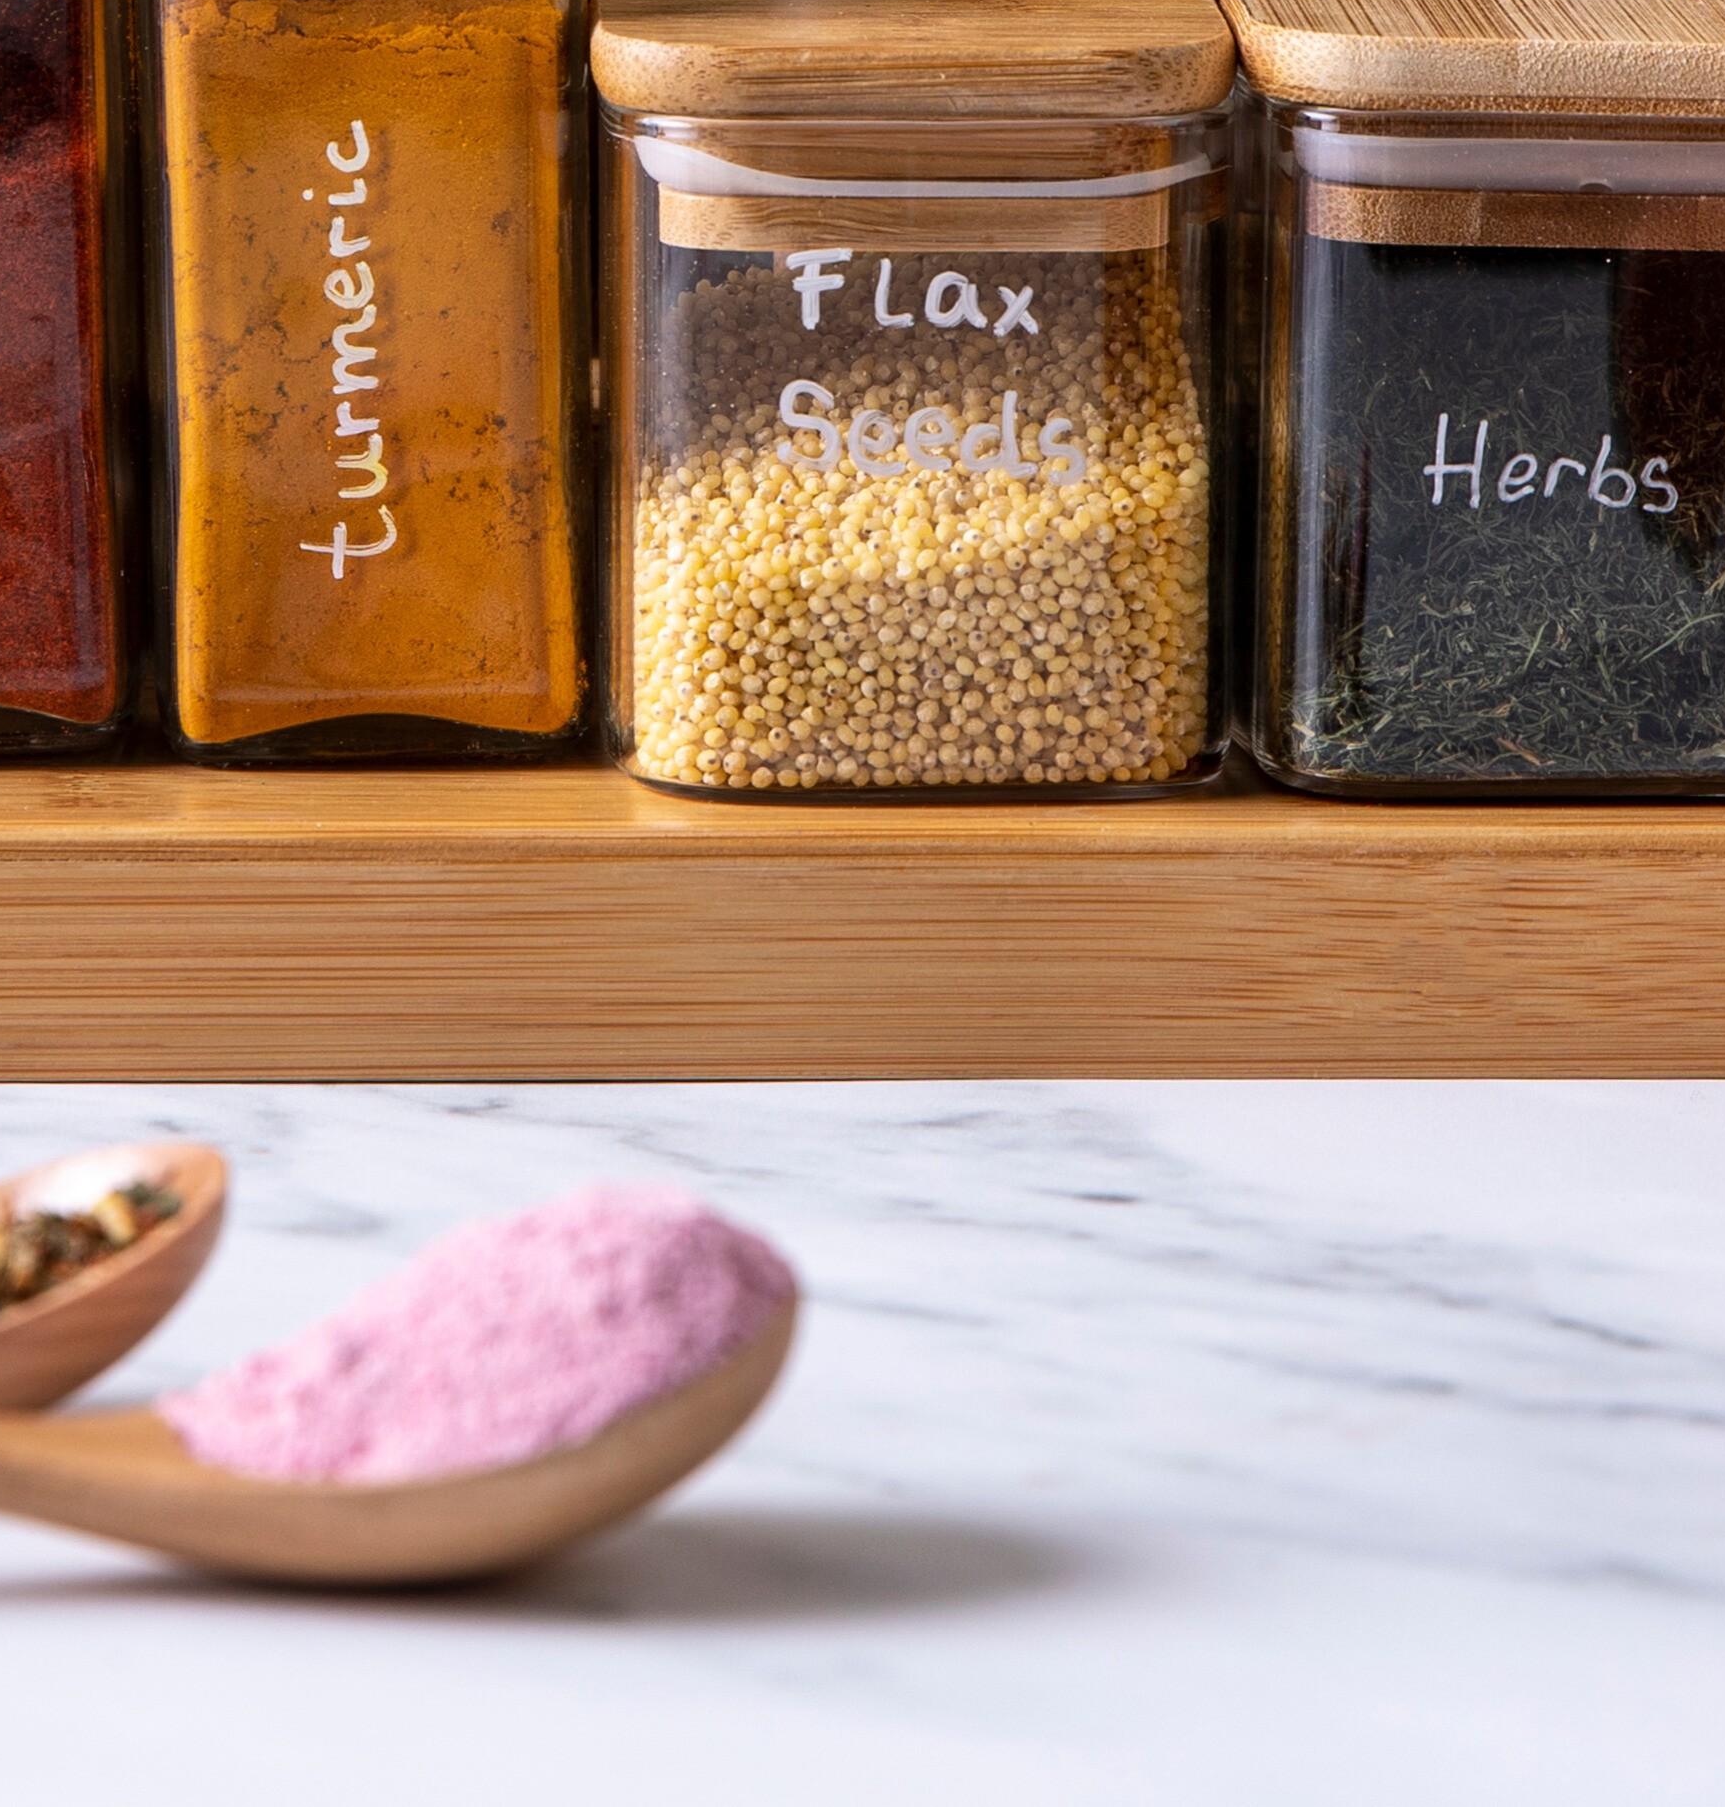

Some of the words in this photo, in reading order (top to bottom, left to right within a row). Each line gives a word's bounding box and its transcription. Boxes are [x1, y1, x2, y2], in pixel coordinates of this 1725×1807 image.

[786, 247, 1040, 337] Flax
[776, 378, 1088, 486] Seeds
[1422, 413, 1680, 512] Herbs
